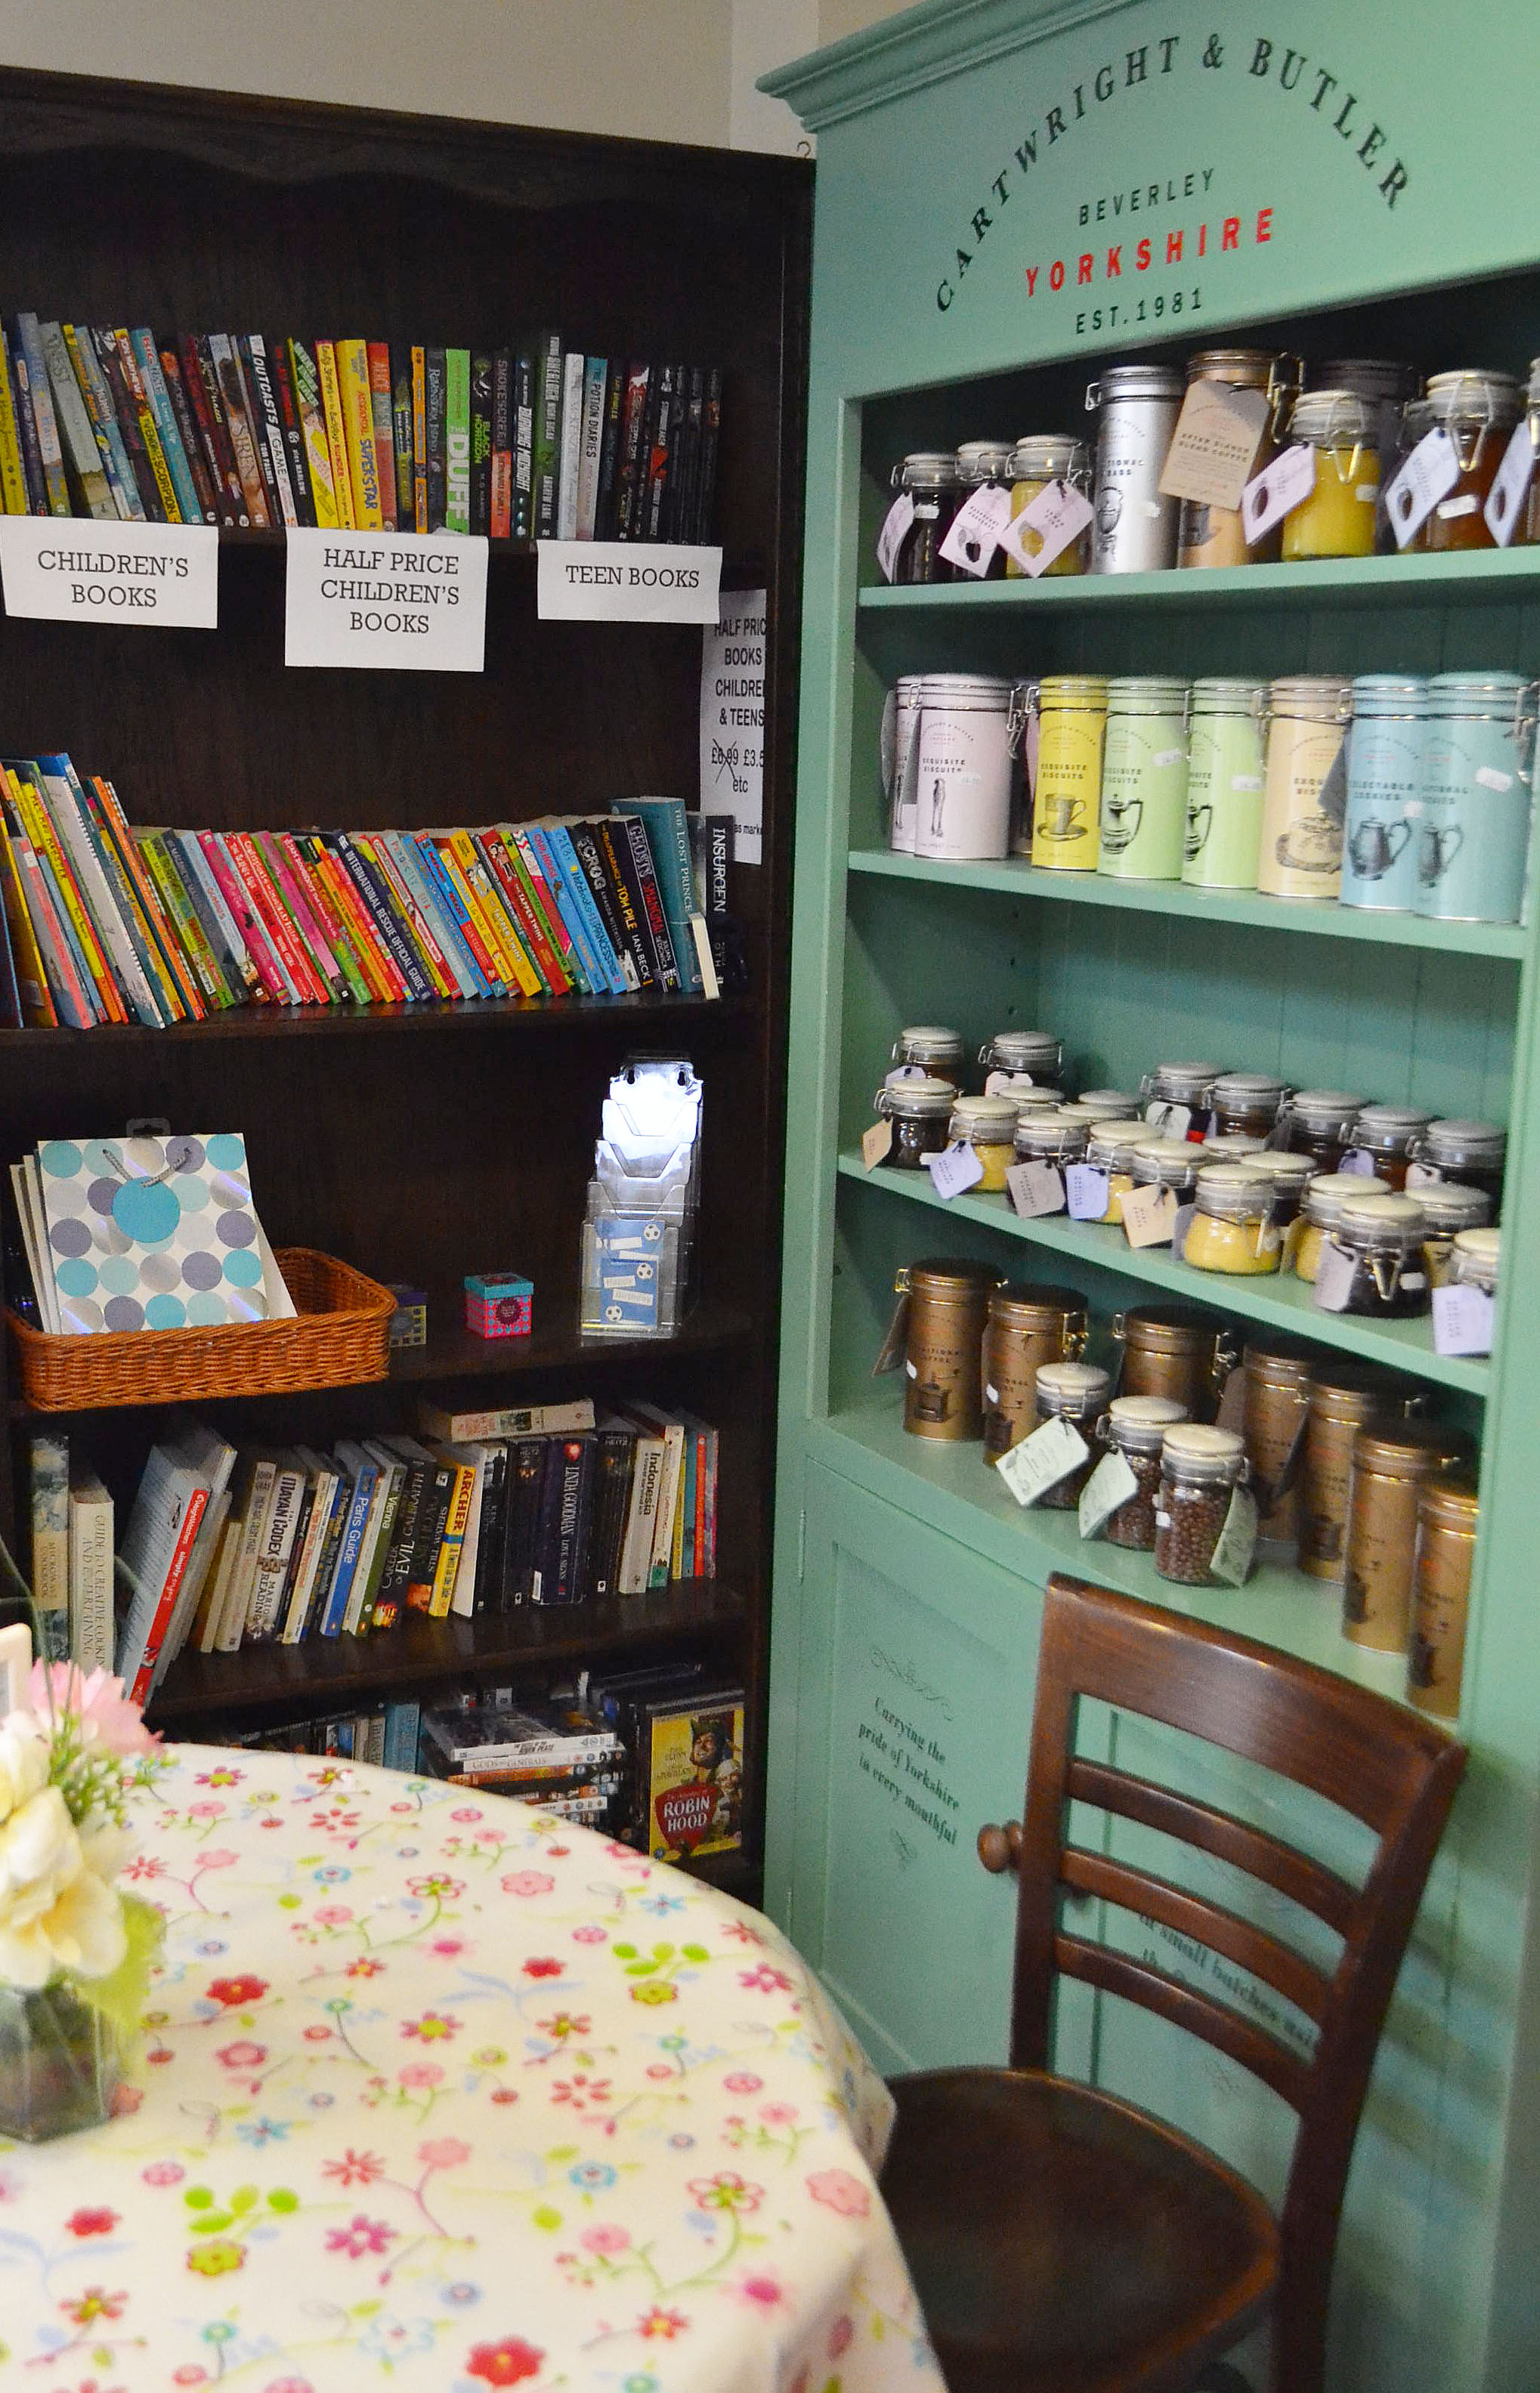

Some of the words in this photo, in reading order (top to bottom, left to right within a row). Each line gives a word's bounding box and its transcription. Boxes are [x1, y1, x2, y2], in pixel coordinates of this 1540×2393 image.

[935, 36, 1180, 313] CARTWRIGHT
[1201, 33, 1224, 70] &
[1249, 37, 1409, 209] BUTLER
[1078, 168, 1215, 227] BEVERLEY
[1025, 207, 1274, 298] YORKSHIRE
[1075, 287, 1203, 335] EST.1981
[252, 357, 278, 426] OUTCASTS
[545, 356, 561, 400] SHERLOCK
[496, 359, 508, 447] SMOKESCREEN
[589, 384, 601, 418] POTION
[474, 413, 483, 464] HORIZON
[482, 421, 490, 458] BLACK
[585, 420, 599, 458] DIARIES
[271, 437, 287, 476] GAME
[360, 438, 377, 509] SUPERSTAR
[517, 447, 530, 492] MIDNIGHT
[153, 460, 178, 515] SCORPION
[447, 434, 469, 520] DUFF
[38, 549, 188, 577] CHILDREN'S
[324, 549, 385, 572] HALF
[390, 552, 459, 577] PRICE
[565, 564, 623, 586] TEEN
[628, 566, 700, 589] BOOKS
[71, 583, 157, 608] BOOKS
[320, 579, 459, 606] CHILDREN'S
[350, 611, 430, 635] BOOKS
[714, 617, 741, 637] HALF
[724, 647, 762, 666] BOOKS
[715, 679, 764, 697] CHILDRE
[719, 707, 727, 725] &
[730, 708, 765, 727] TEENS
[732, 775, 749, 793] etc
[676, 831, 688, 863] LOST
[616, 886, 631, 907] TOM
[680, 867, 693, 912] PRINCE
[344, 851, 381, 909] INTERNATIONAL
[376, 908, 397, 938] RESCUE
[390, 936, 413, 969] OFFICIAL
[407, 967, 425, 991] GUIDE
[518, 893, 534, 920] TAPPER
[530, 920, 545, 942] TWINS
[571, 871, 594, 913] Notebooks
[591, 923, 614, 961] PRINCESS
[622, 907, 639, 932] PILE
[507, 937, 524, 963] TWINS
[631, 934, 643, 952] IAN
[636, 953, 651, 979] BECK
[564, 1466, 580, 1492] LINDA
[642, 1452, 661, 1516] Indonesia
[274, 1476, 297, 1518] MAYAN
[352, 1496, 369, 1528] Paris
[382, 1495, 398, 1529] Vienna
[453, 1469, 474, 1532] ARCHER
[560, 1492, 579, 1536] GOODMAN
[94, 1515, 106, 1548] GUIDE
[266, 1518, 289, 1557] CODEX
[342, 1529, 361, 1565] Guide
[82, 1538, 92, 1563] AND
[172, 1550, 187, 1578] simply
[394, 1539, 415, 1575] EVIL
[95, 1569, 106, 1621] CREATIVE
[262, 1580, 277, 1615] MARIO
[858, 1723, 888, 1752] pride
[927, 1740, 946, 1766] the
[663, 1795, 710, 1819] ROBIN
[858, 1752, 870, 1773] in
[905, 1794, 958, 1847] mouthful
[667, 1813, 708, 1832] HOOD
